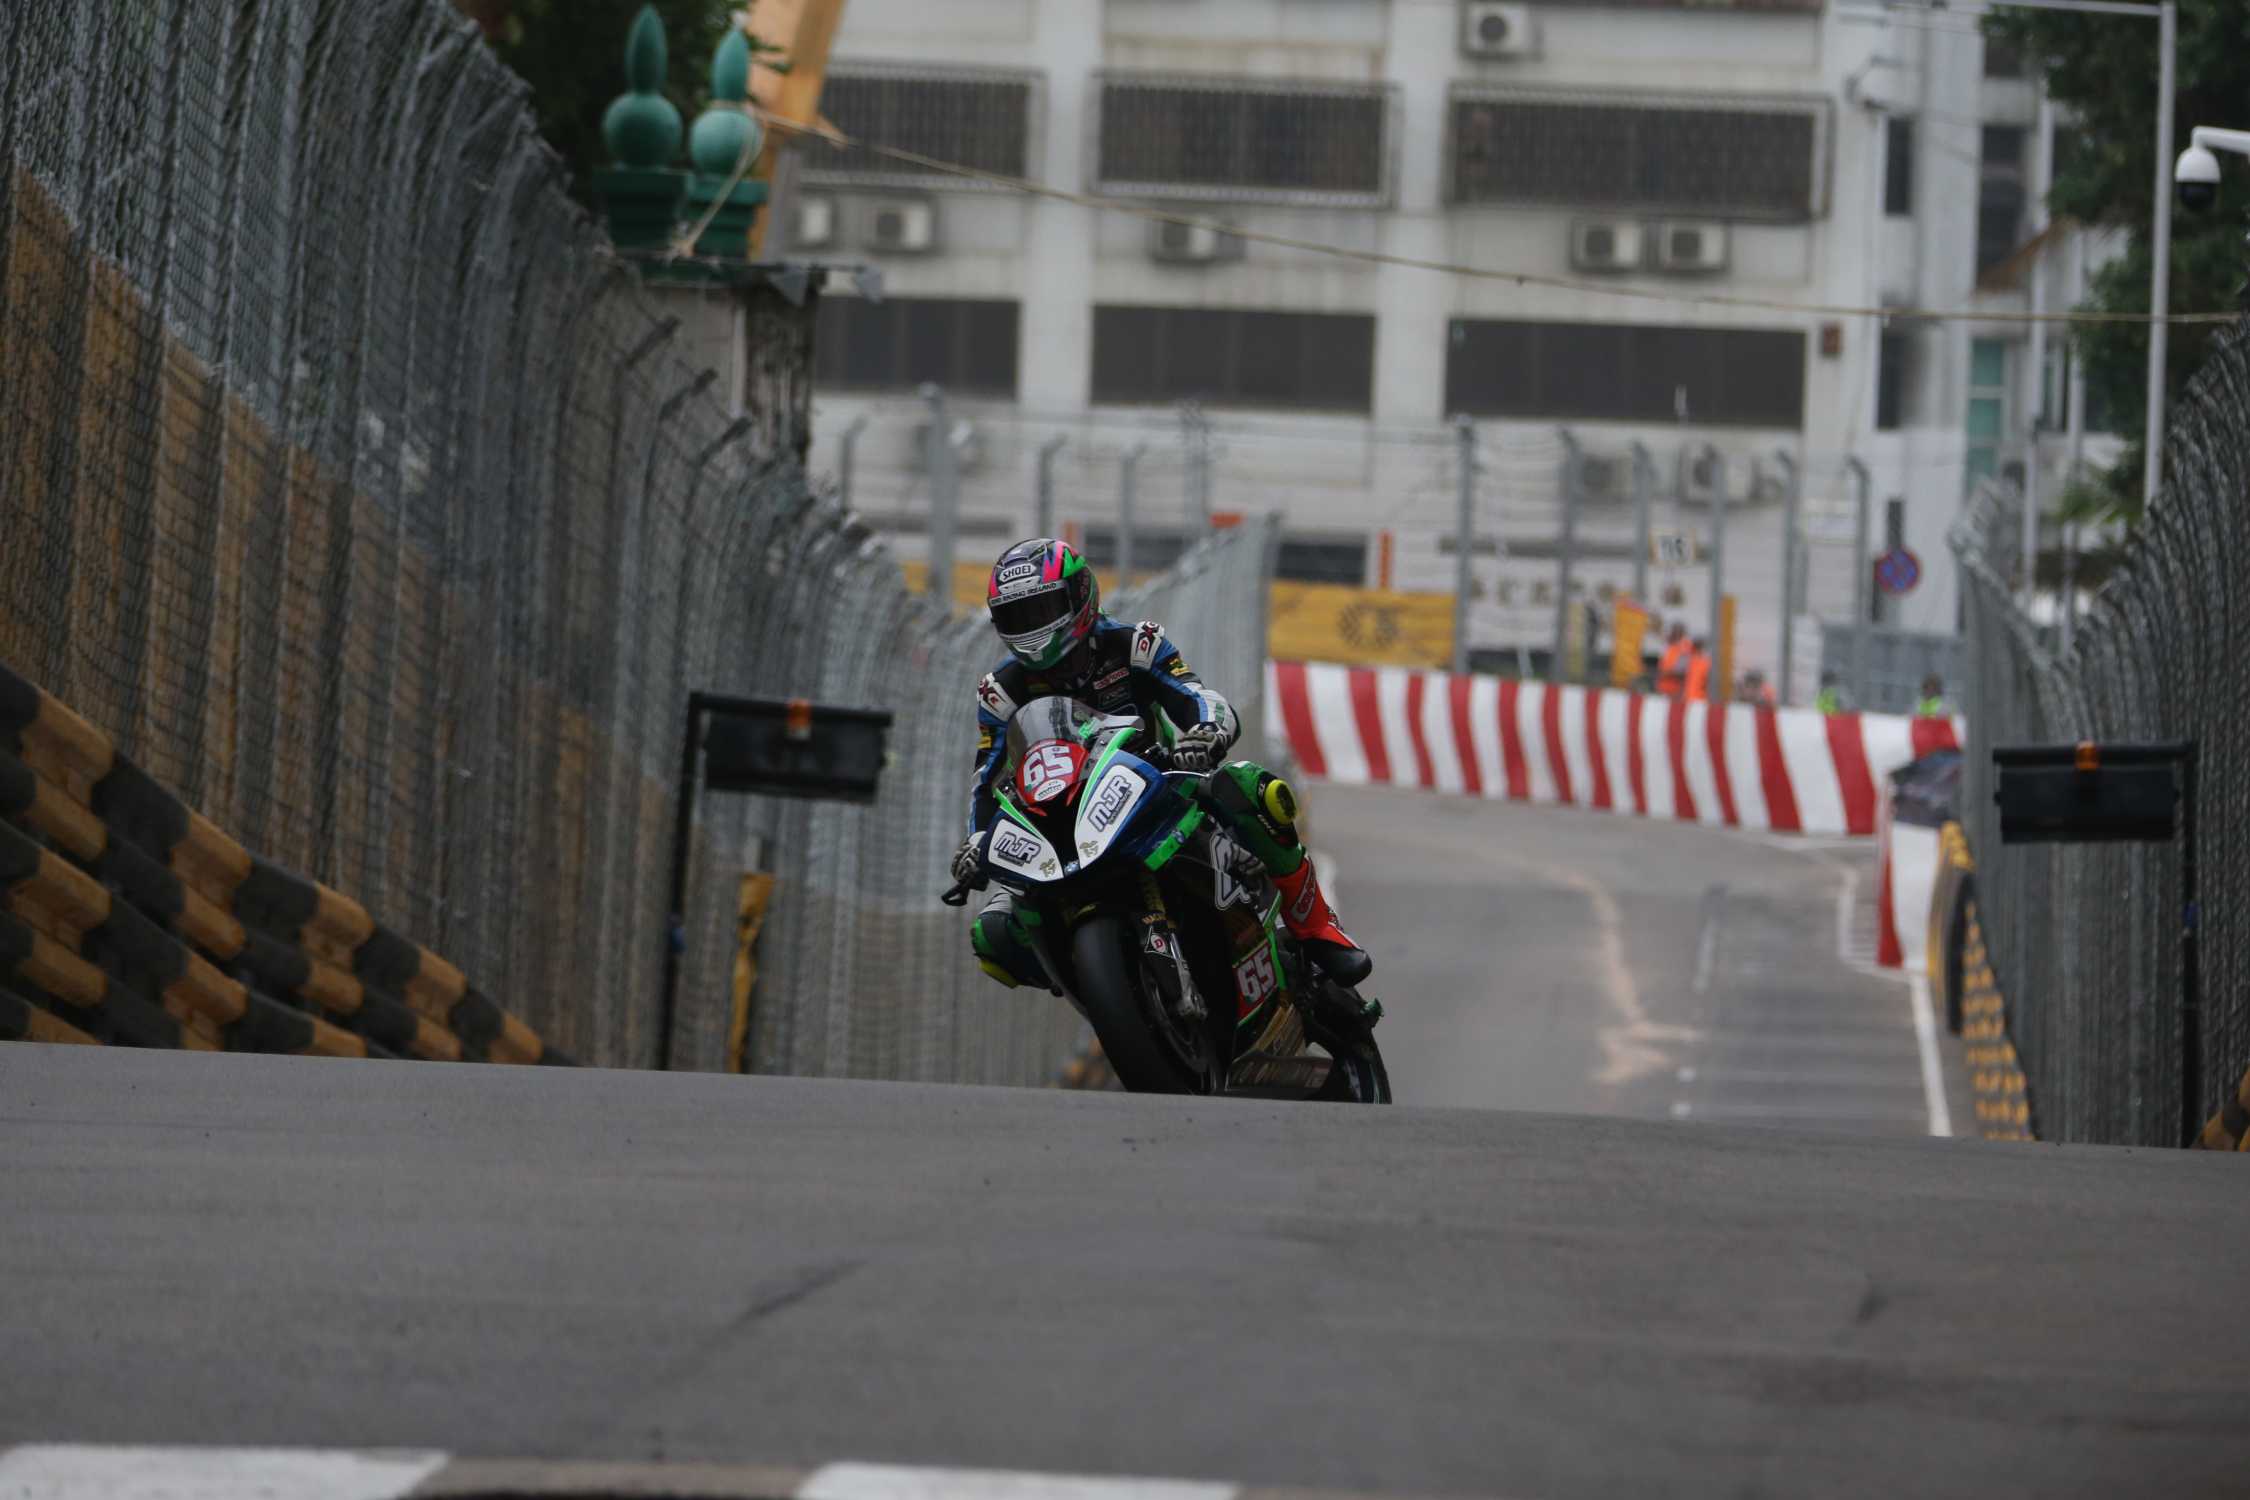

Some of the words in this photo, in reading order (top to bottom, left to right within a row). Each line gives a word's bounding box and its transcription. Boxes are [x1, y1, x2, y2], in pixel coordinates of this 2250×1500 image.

[1002, 565, 1031, 580] SHOEI
[1023, 745, 1074, 791] 65
[1088, 774, 1131, 832] MJR
[994, 831, 1041, 864] MJR
[1236, 945, 1277, 1004] 65
